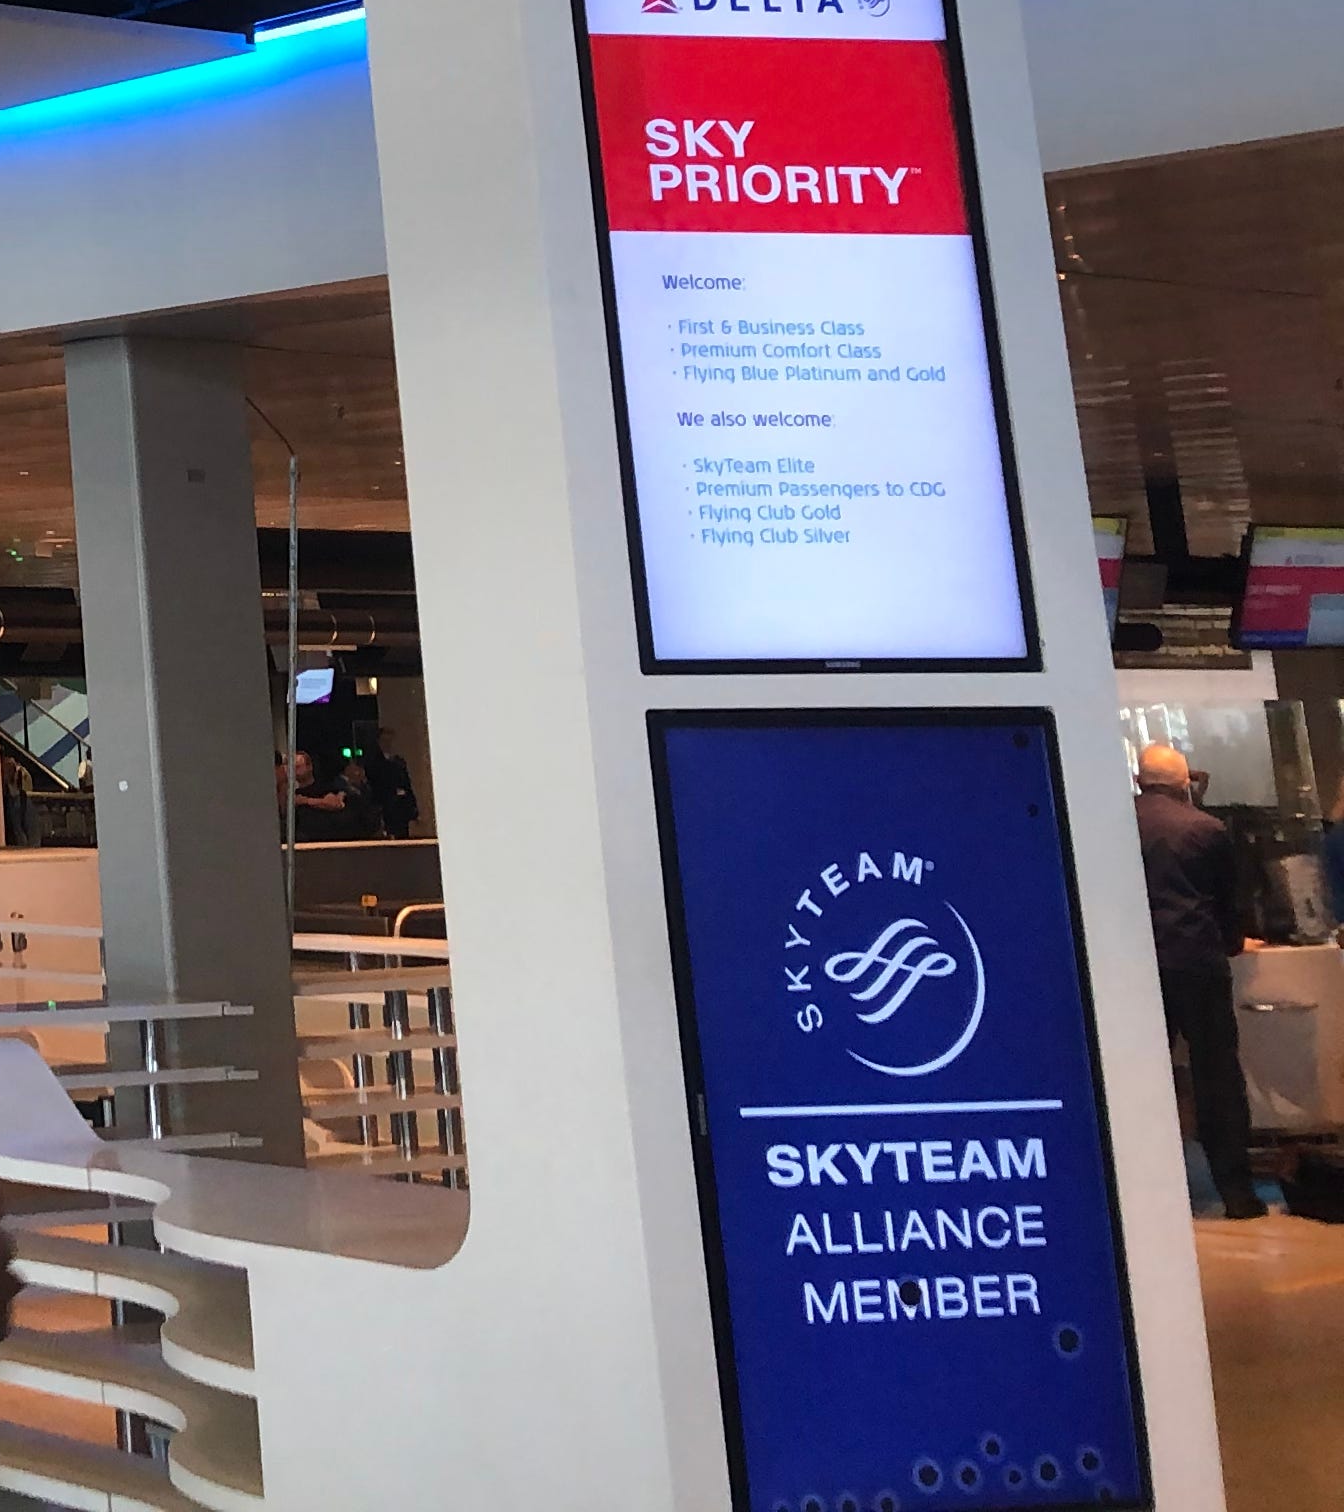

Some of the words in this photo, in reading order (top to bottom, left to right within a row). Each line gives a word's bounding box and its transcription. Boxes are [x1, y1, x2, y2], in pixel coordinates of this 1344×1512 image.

[645, 118, 755, 158] SKY
[678, 319, 715, 336] First
[738, 319, 815, 336] Business
[820, 320, 865, 337] Class
[681, 342, 757, 358] Premium
[762, 342, 831, 358] Comfort
[837, 343, 882, 359] Class
[684, 365, 736, 384] Flying
[741, 365, 779, 381] Blue
[785, 365, 862, 382] Platinum
[867, 365, 901, 382] and
[906, 366, 946, 382] Gold
[677, 412, 704, 427] We
[711, 411, 747, 427] also
[693, 457, 772, 476] SkyTeam
[777, 458, 815, 474] Elite
[696, 480, 773, 497] Premium
[778, 481, 880, 500] Passengers
[886, 481, 904, 497] to
[910, 481, 947, 497] CDG
[699, 504, 752, 523] Flying
[757, 504, 796, 521] Club
[801, 504, 842, 521] Gold
[701, 528, 754, 547] Flying
[760, 527, 799, 544] Club
[804, 527, 850, 544] Silver
[784, 851, 923, 1033] SKYTEAM
[765, 1137, 1048, 1188] SKYTEAM
[785, 1204, 1048, 1257] ALLIANCE
[802, 1273, 1042, 1325] MEMBER
